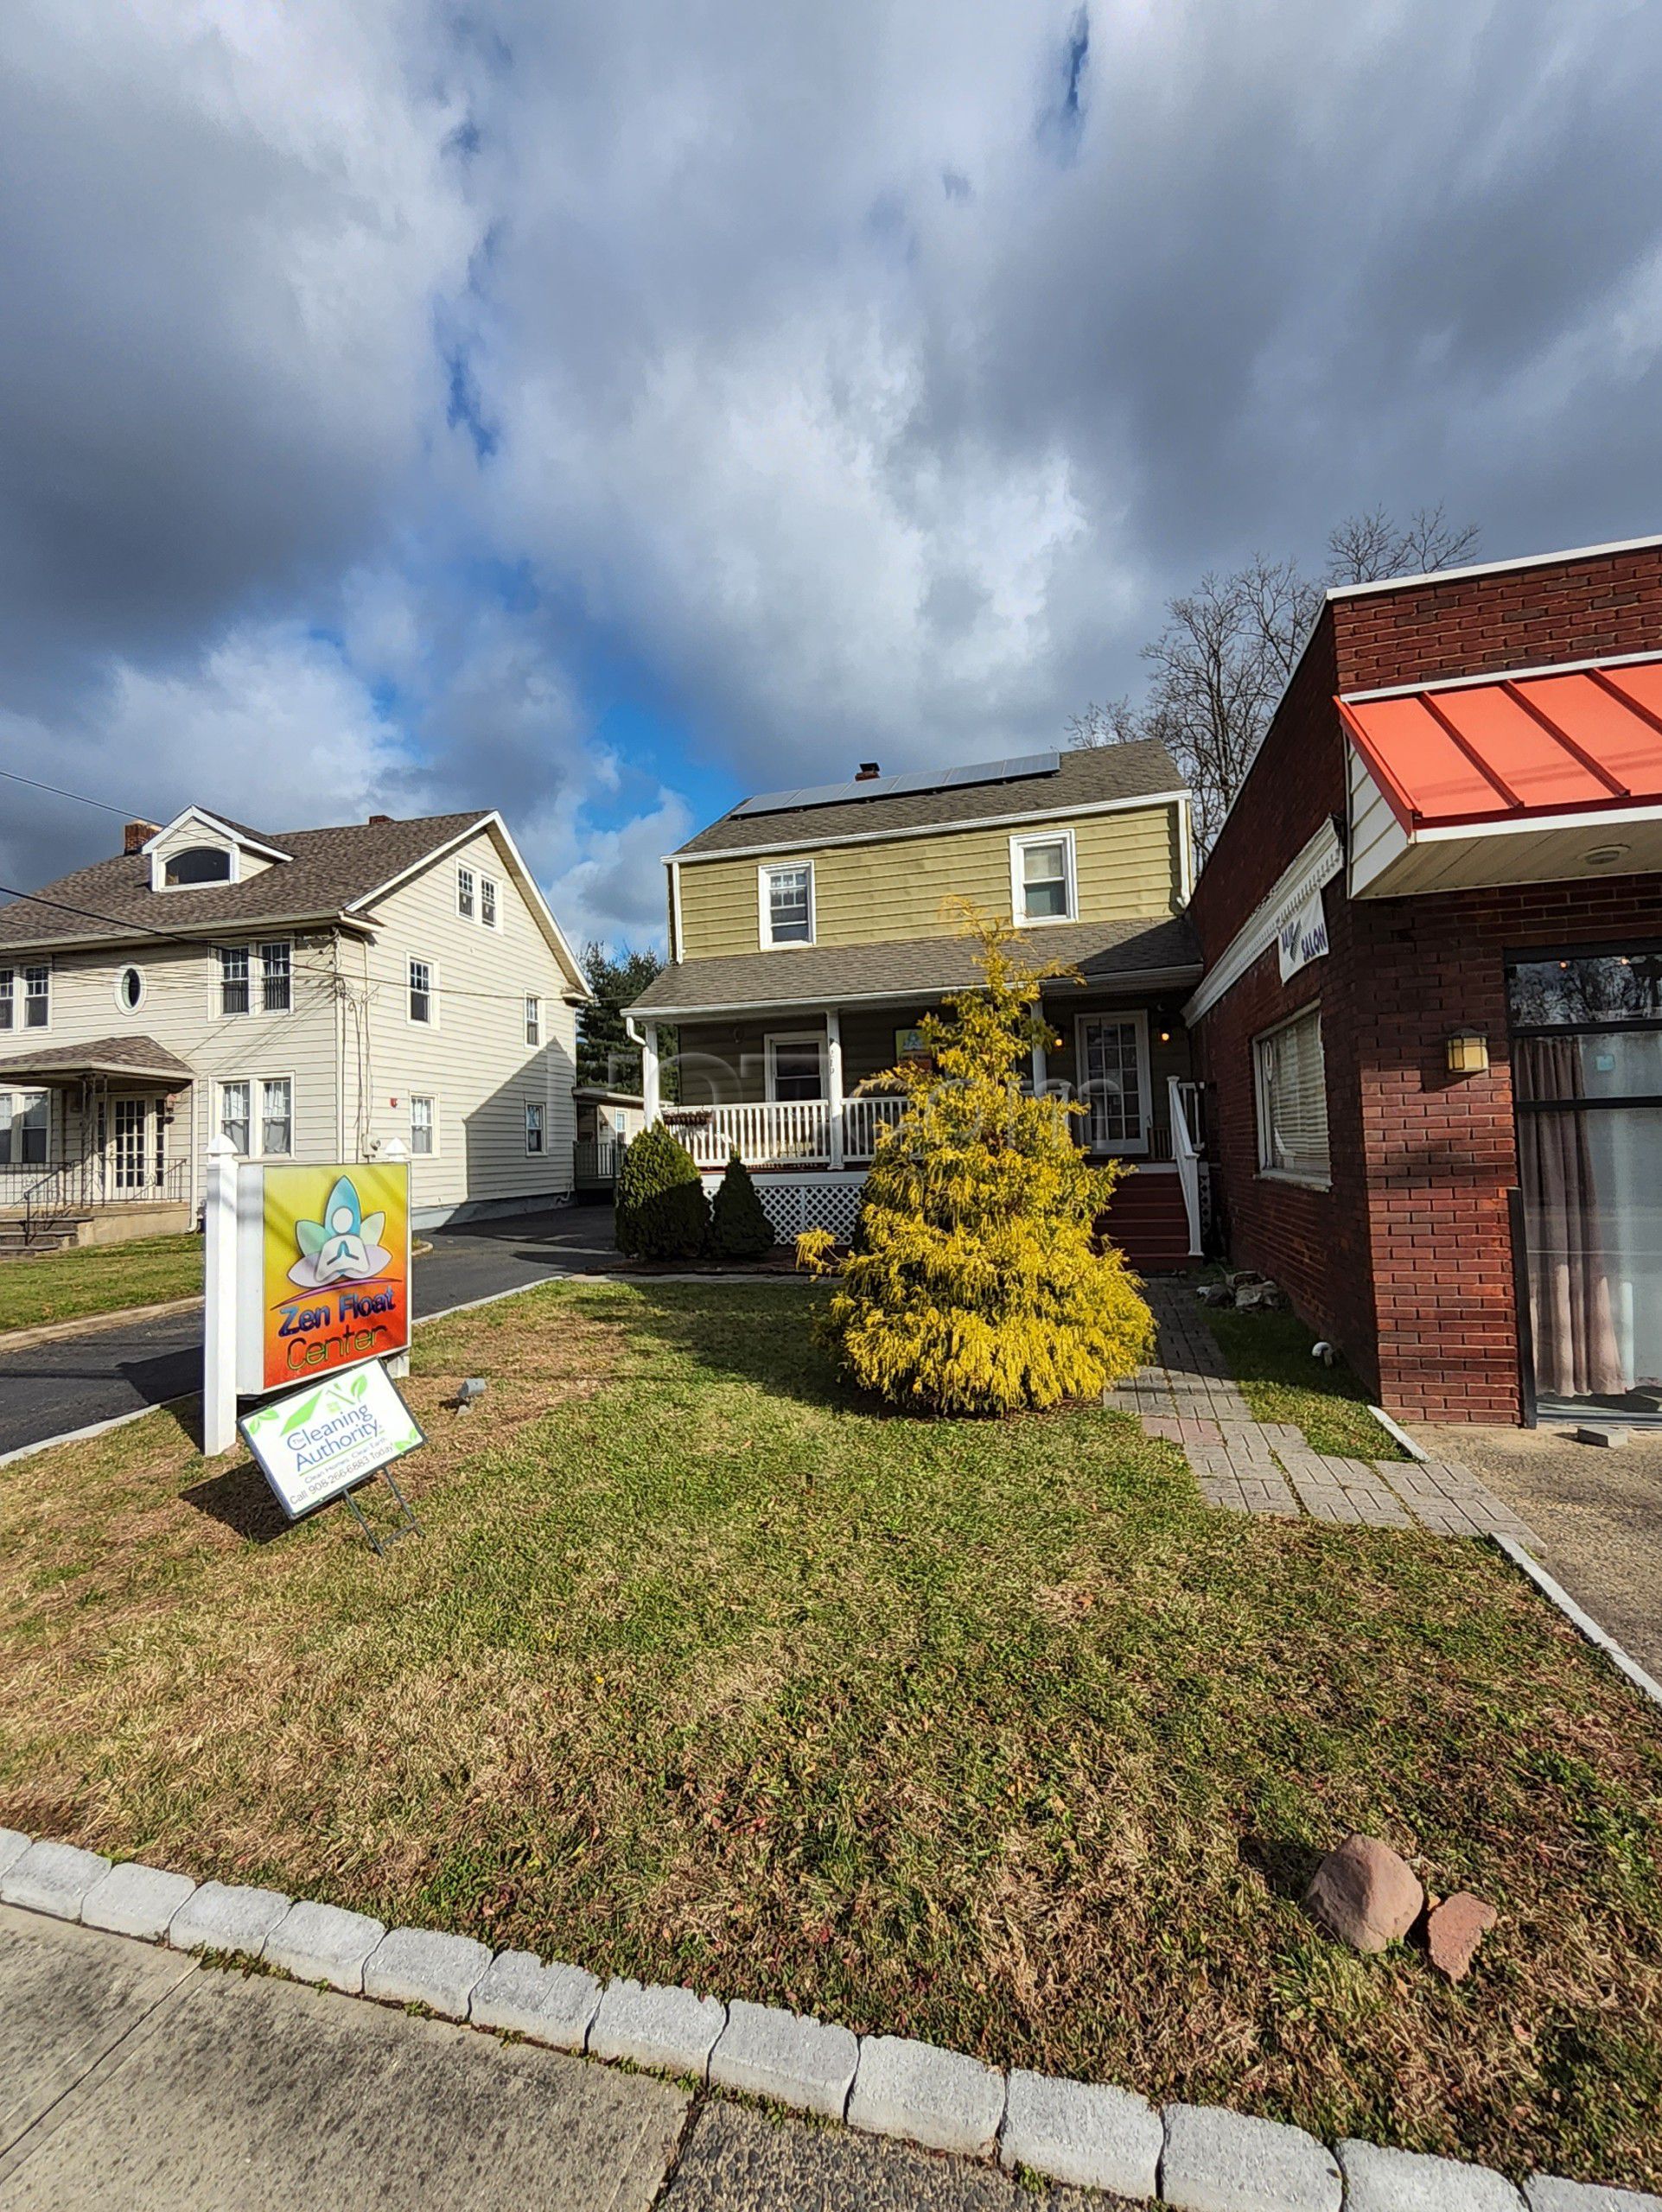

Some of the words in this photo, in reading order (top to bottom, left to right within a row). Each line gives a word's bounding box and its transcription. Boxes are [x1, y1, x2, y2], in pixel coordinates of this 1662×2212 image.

[1301, 923, 1327, 963] SALON
[278, 1305, 330, 1338] Zen
[339, 1285, 396, 1323] Float
[287, 1325, 388, 1371] Center
[287, 1404, 373, 1451] Cleaning
[296, 1419, 378, 1472] Authority
[290, 1491, 308, 1505] Call
